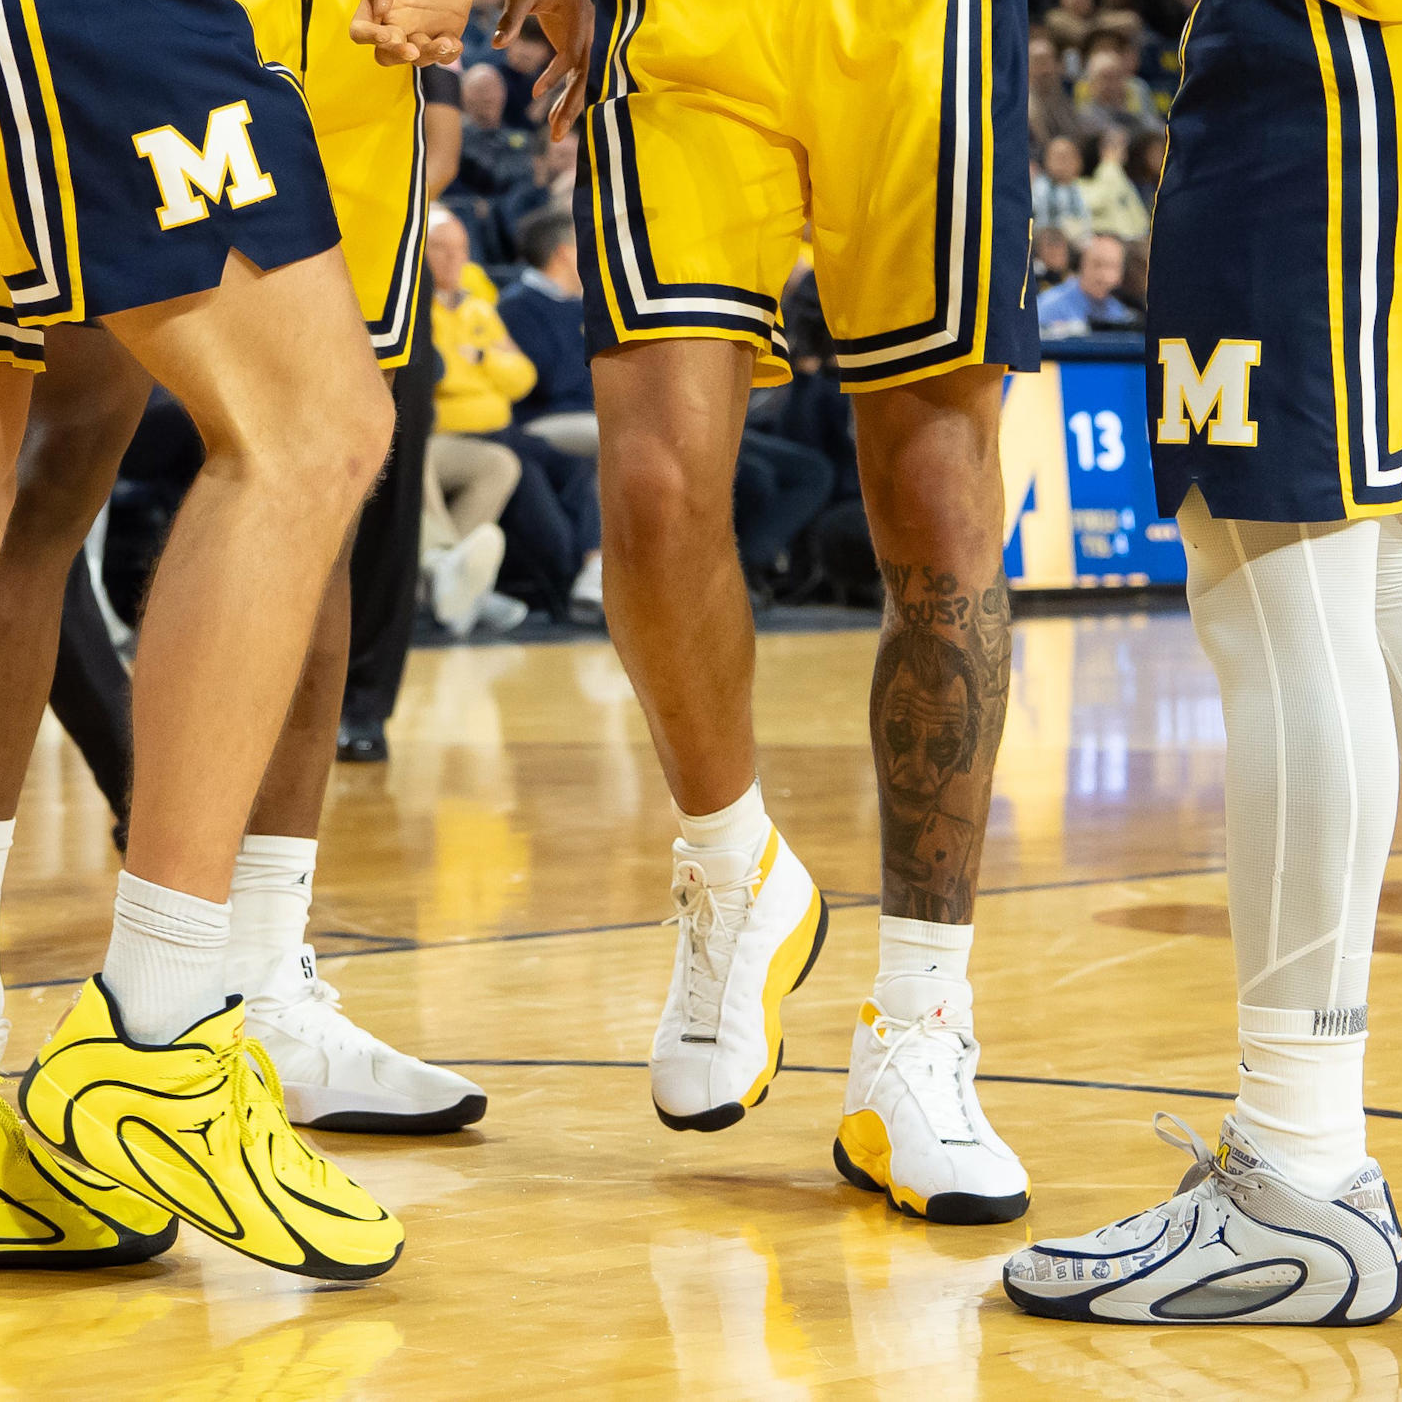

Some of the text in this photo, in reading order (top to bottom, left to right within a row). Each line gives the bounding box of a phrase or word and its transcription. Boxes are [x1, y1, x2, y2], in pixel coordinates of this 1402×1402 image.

[131, 100, 277, 231] M
[1068, 410, 1126, 472] 13
[1156, 338, 1262, 448] M
